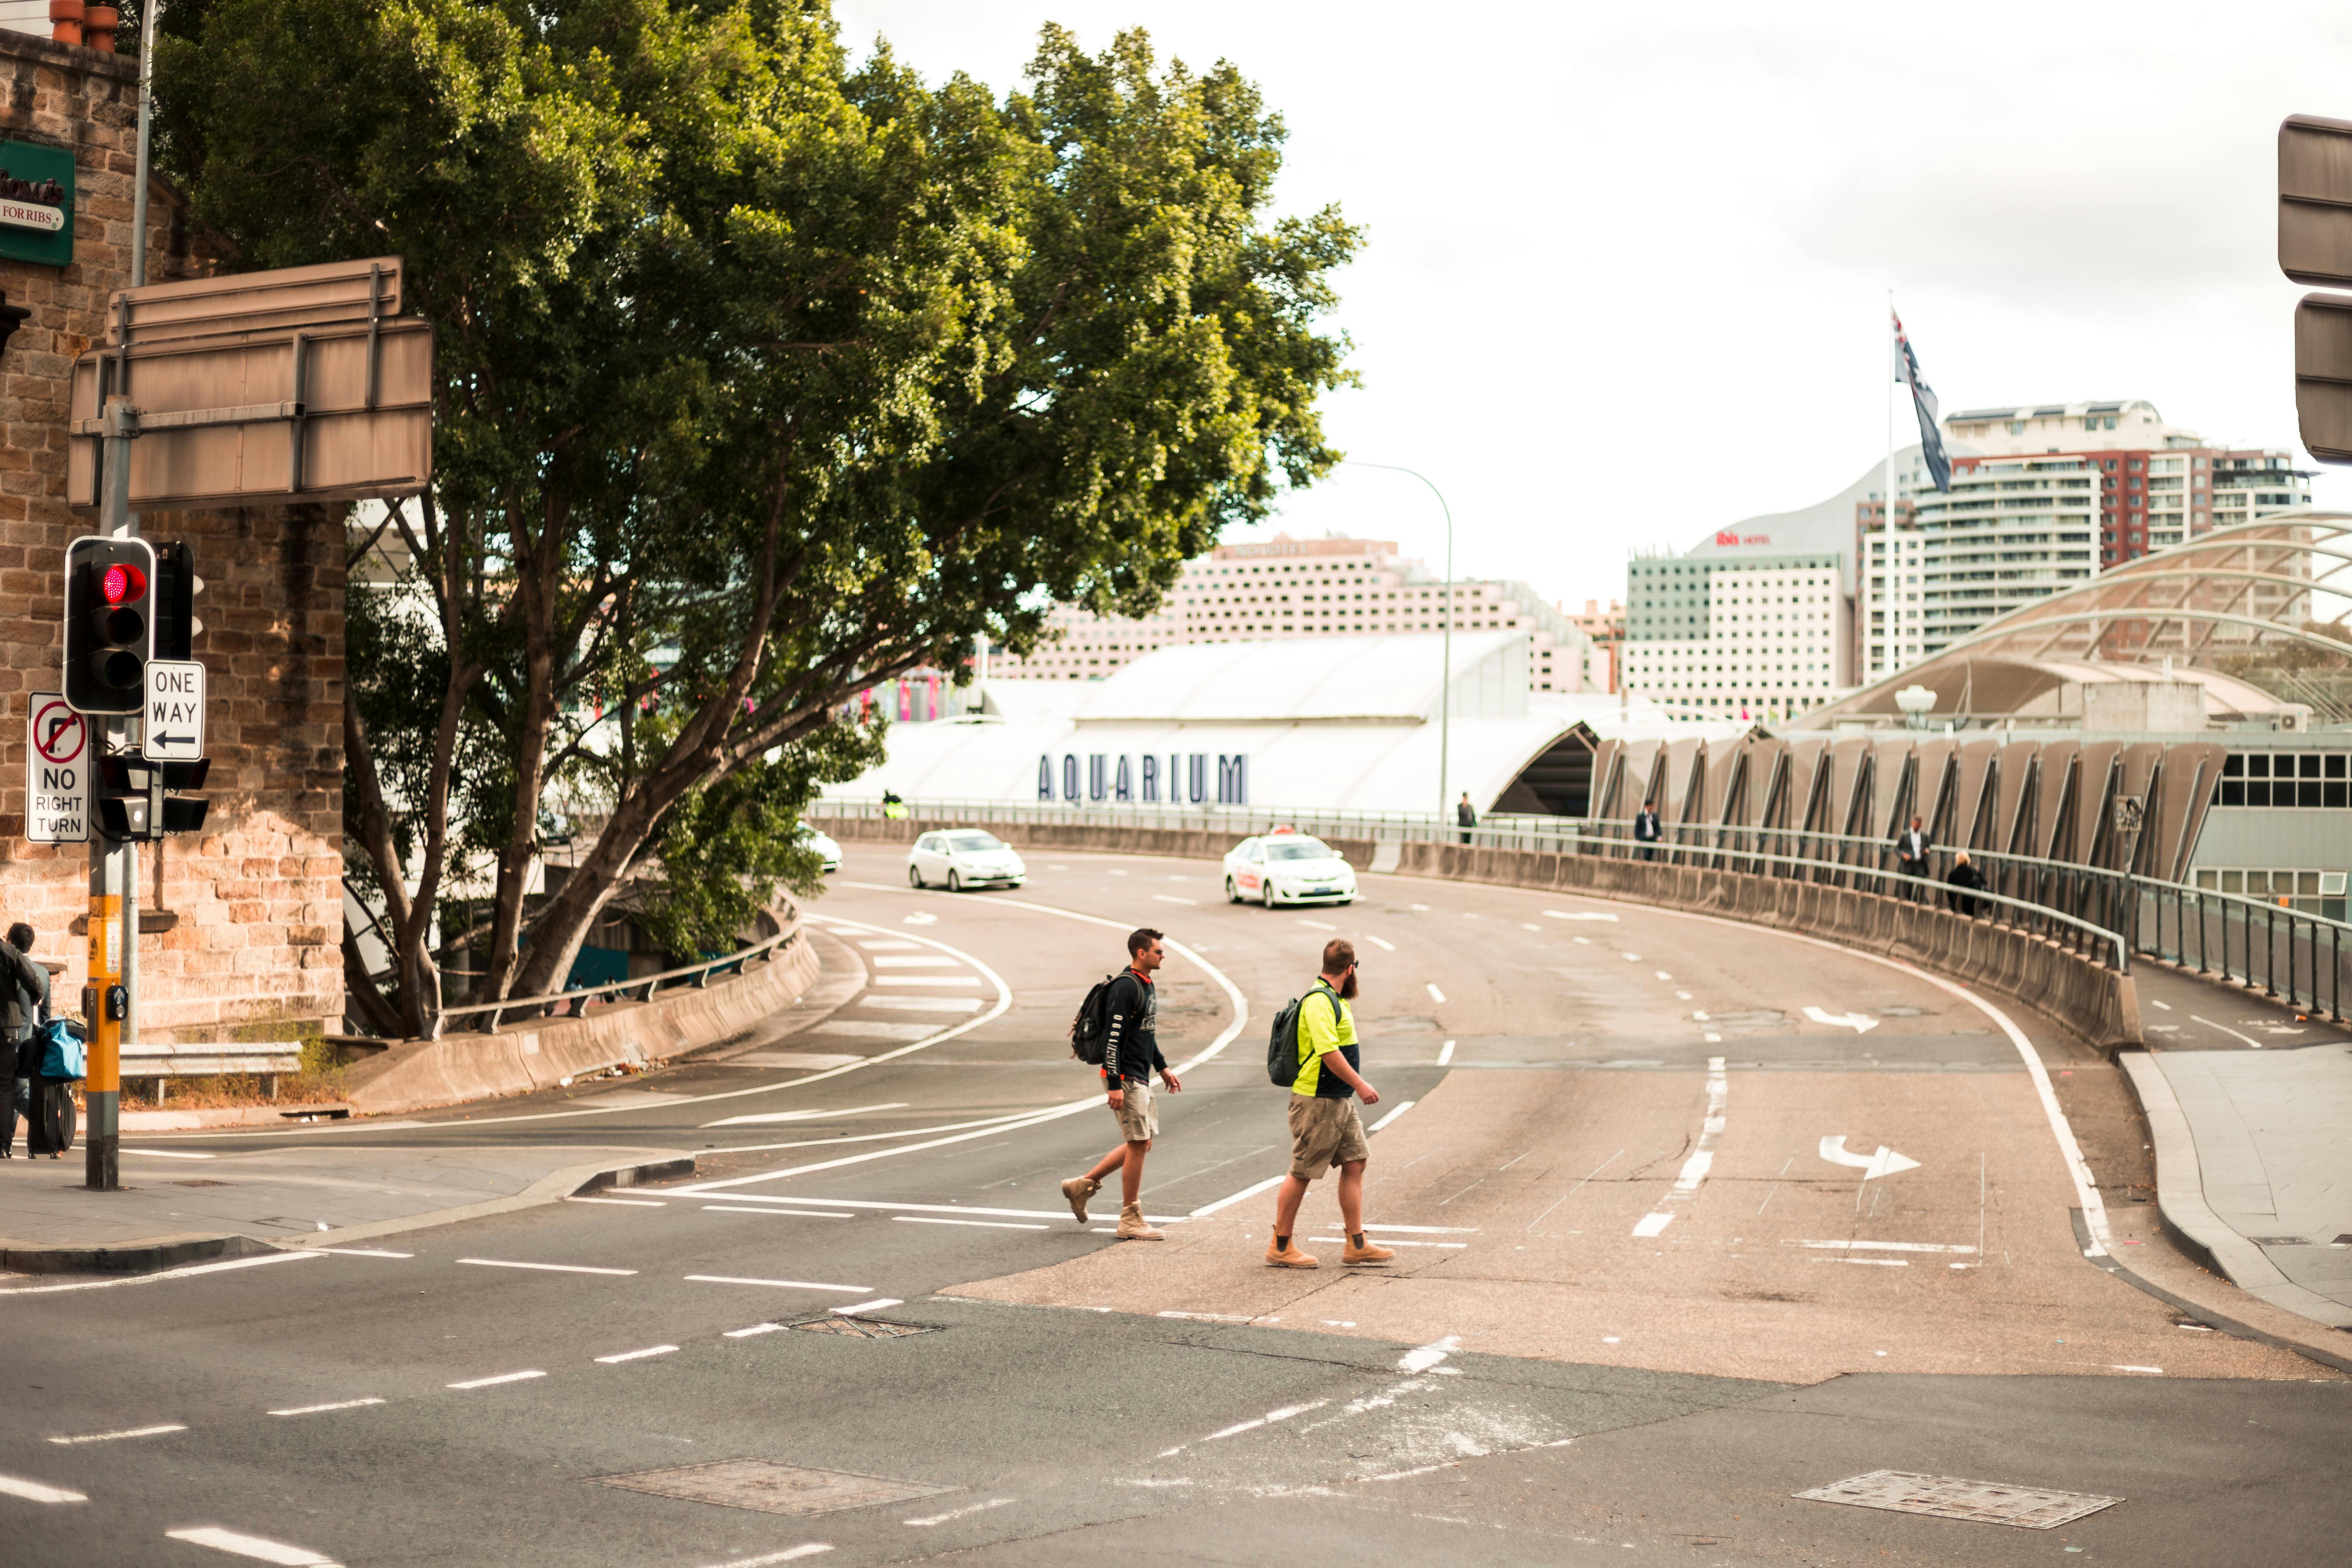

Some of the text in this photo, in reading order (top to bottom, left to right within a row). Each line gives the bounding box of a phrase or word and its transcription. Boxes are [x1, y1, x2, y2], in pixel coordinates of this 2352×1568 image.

[3, 205, 52, 223] FOR RIBS
[1716, 530, 1739, 547] ibis
[156, 671, 194, 693] ONE
[153, 702, 196, 723] WAY
[43, 768, 75, 790] NO
[1038, 754, 1247, 805] AQUARIUM
[37, 797, 82, 812] RIGHT
[37, 818, 81, 833] TURN
[1109, 1014, 1123, 1042] 1990
